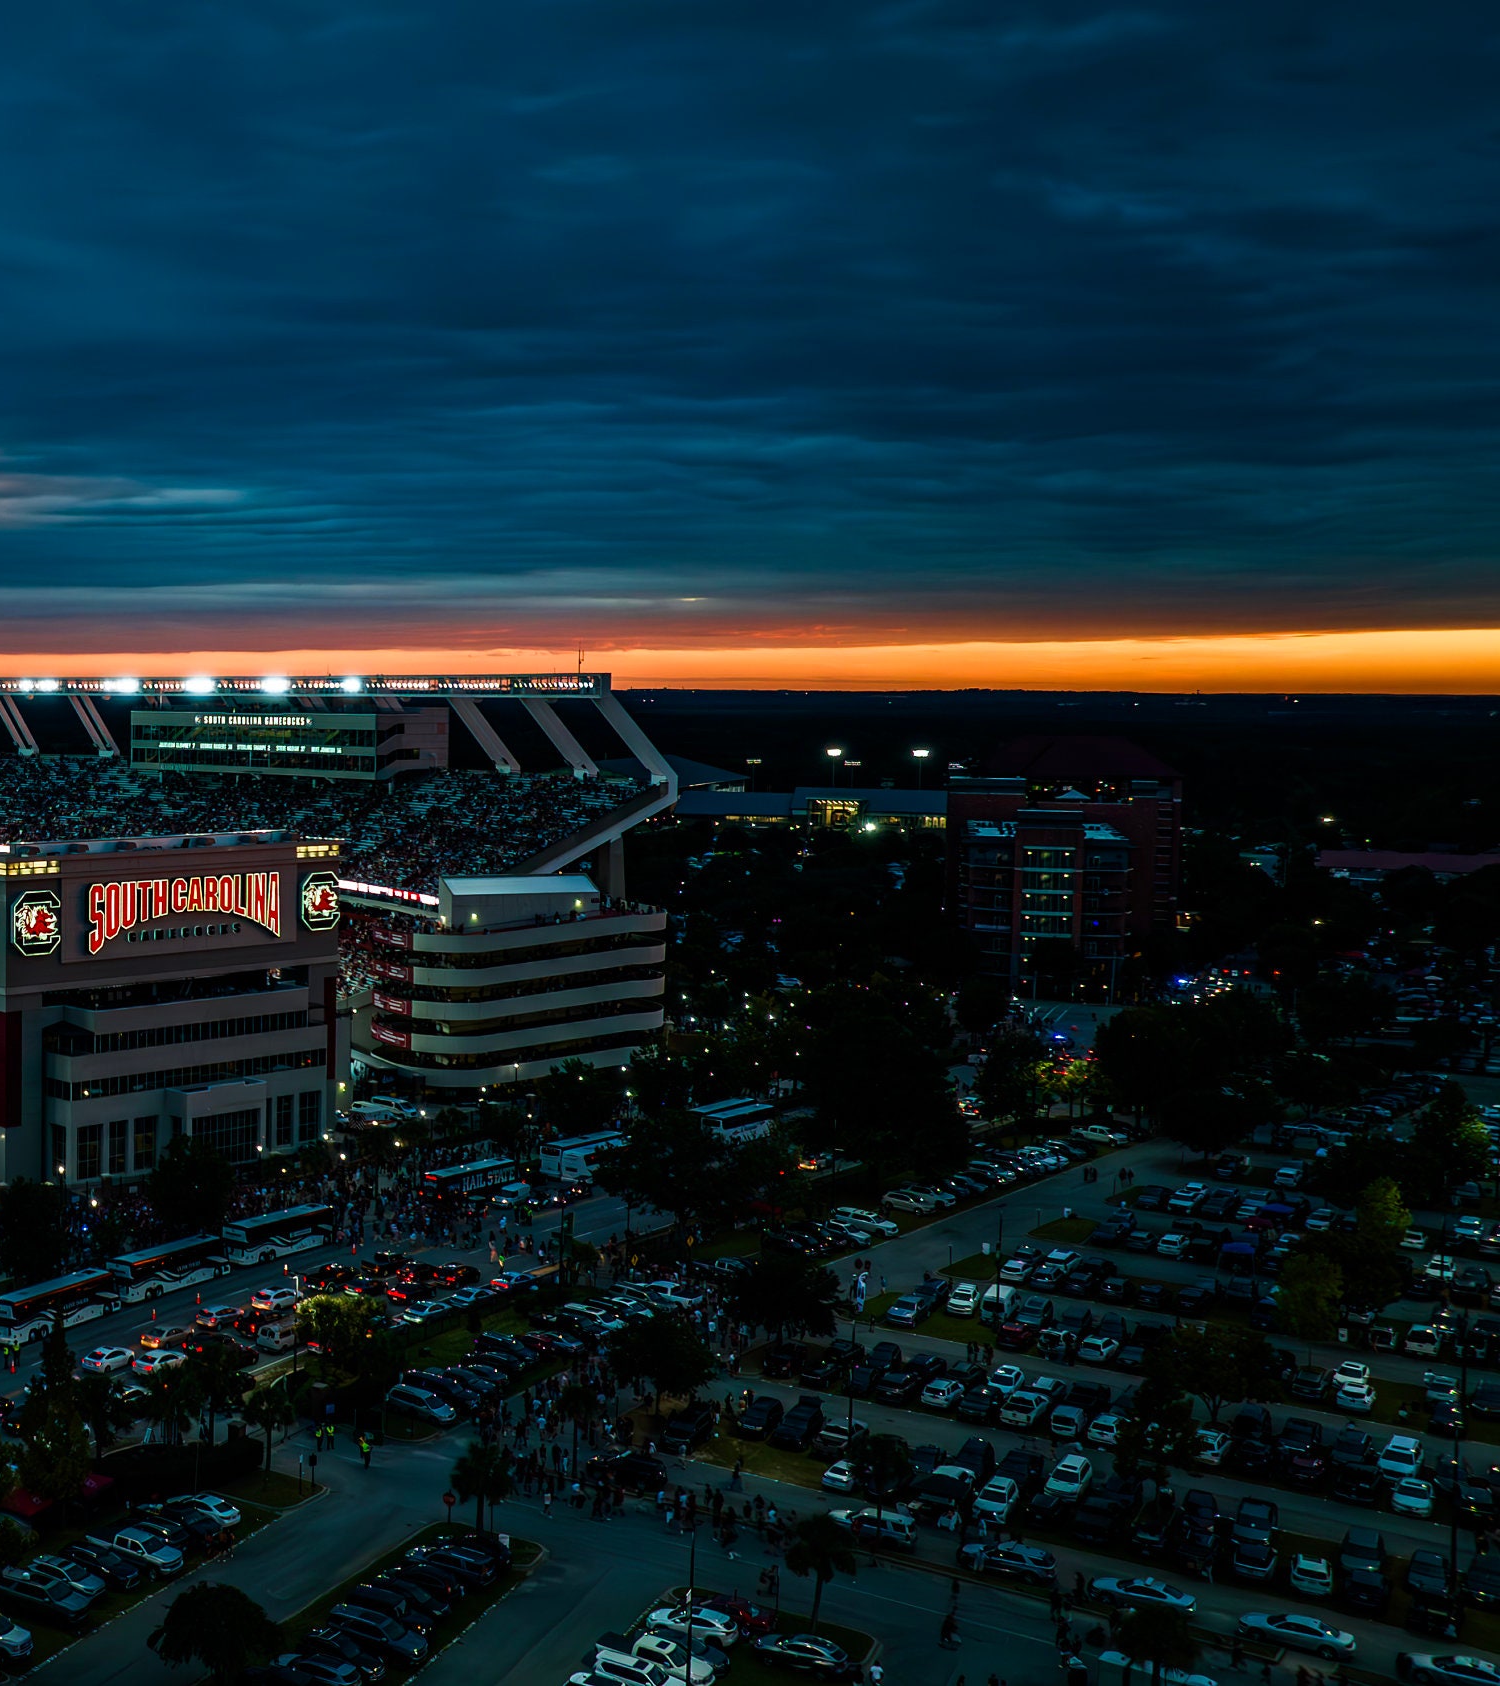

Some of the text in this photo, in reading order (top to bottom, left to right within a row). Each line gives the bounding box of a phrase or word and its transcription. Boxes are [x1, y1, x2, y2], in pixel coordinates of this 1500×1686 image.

[203, 715, 306, 727] SOUTH CAROLINA GAMECOCKS
[88, 871, 281, 956] SOUTH CAROLINA
[127, 922, 241, 943] GAMECOCKS
[462, 1166, 515, 1191] HAIL STATE
